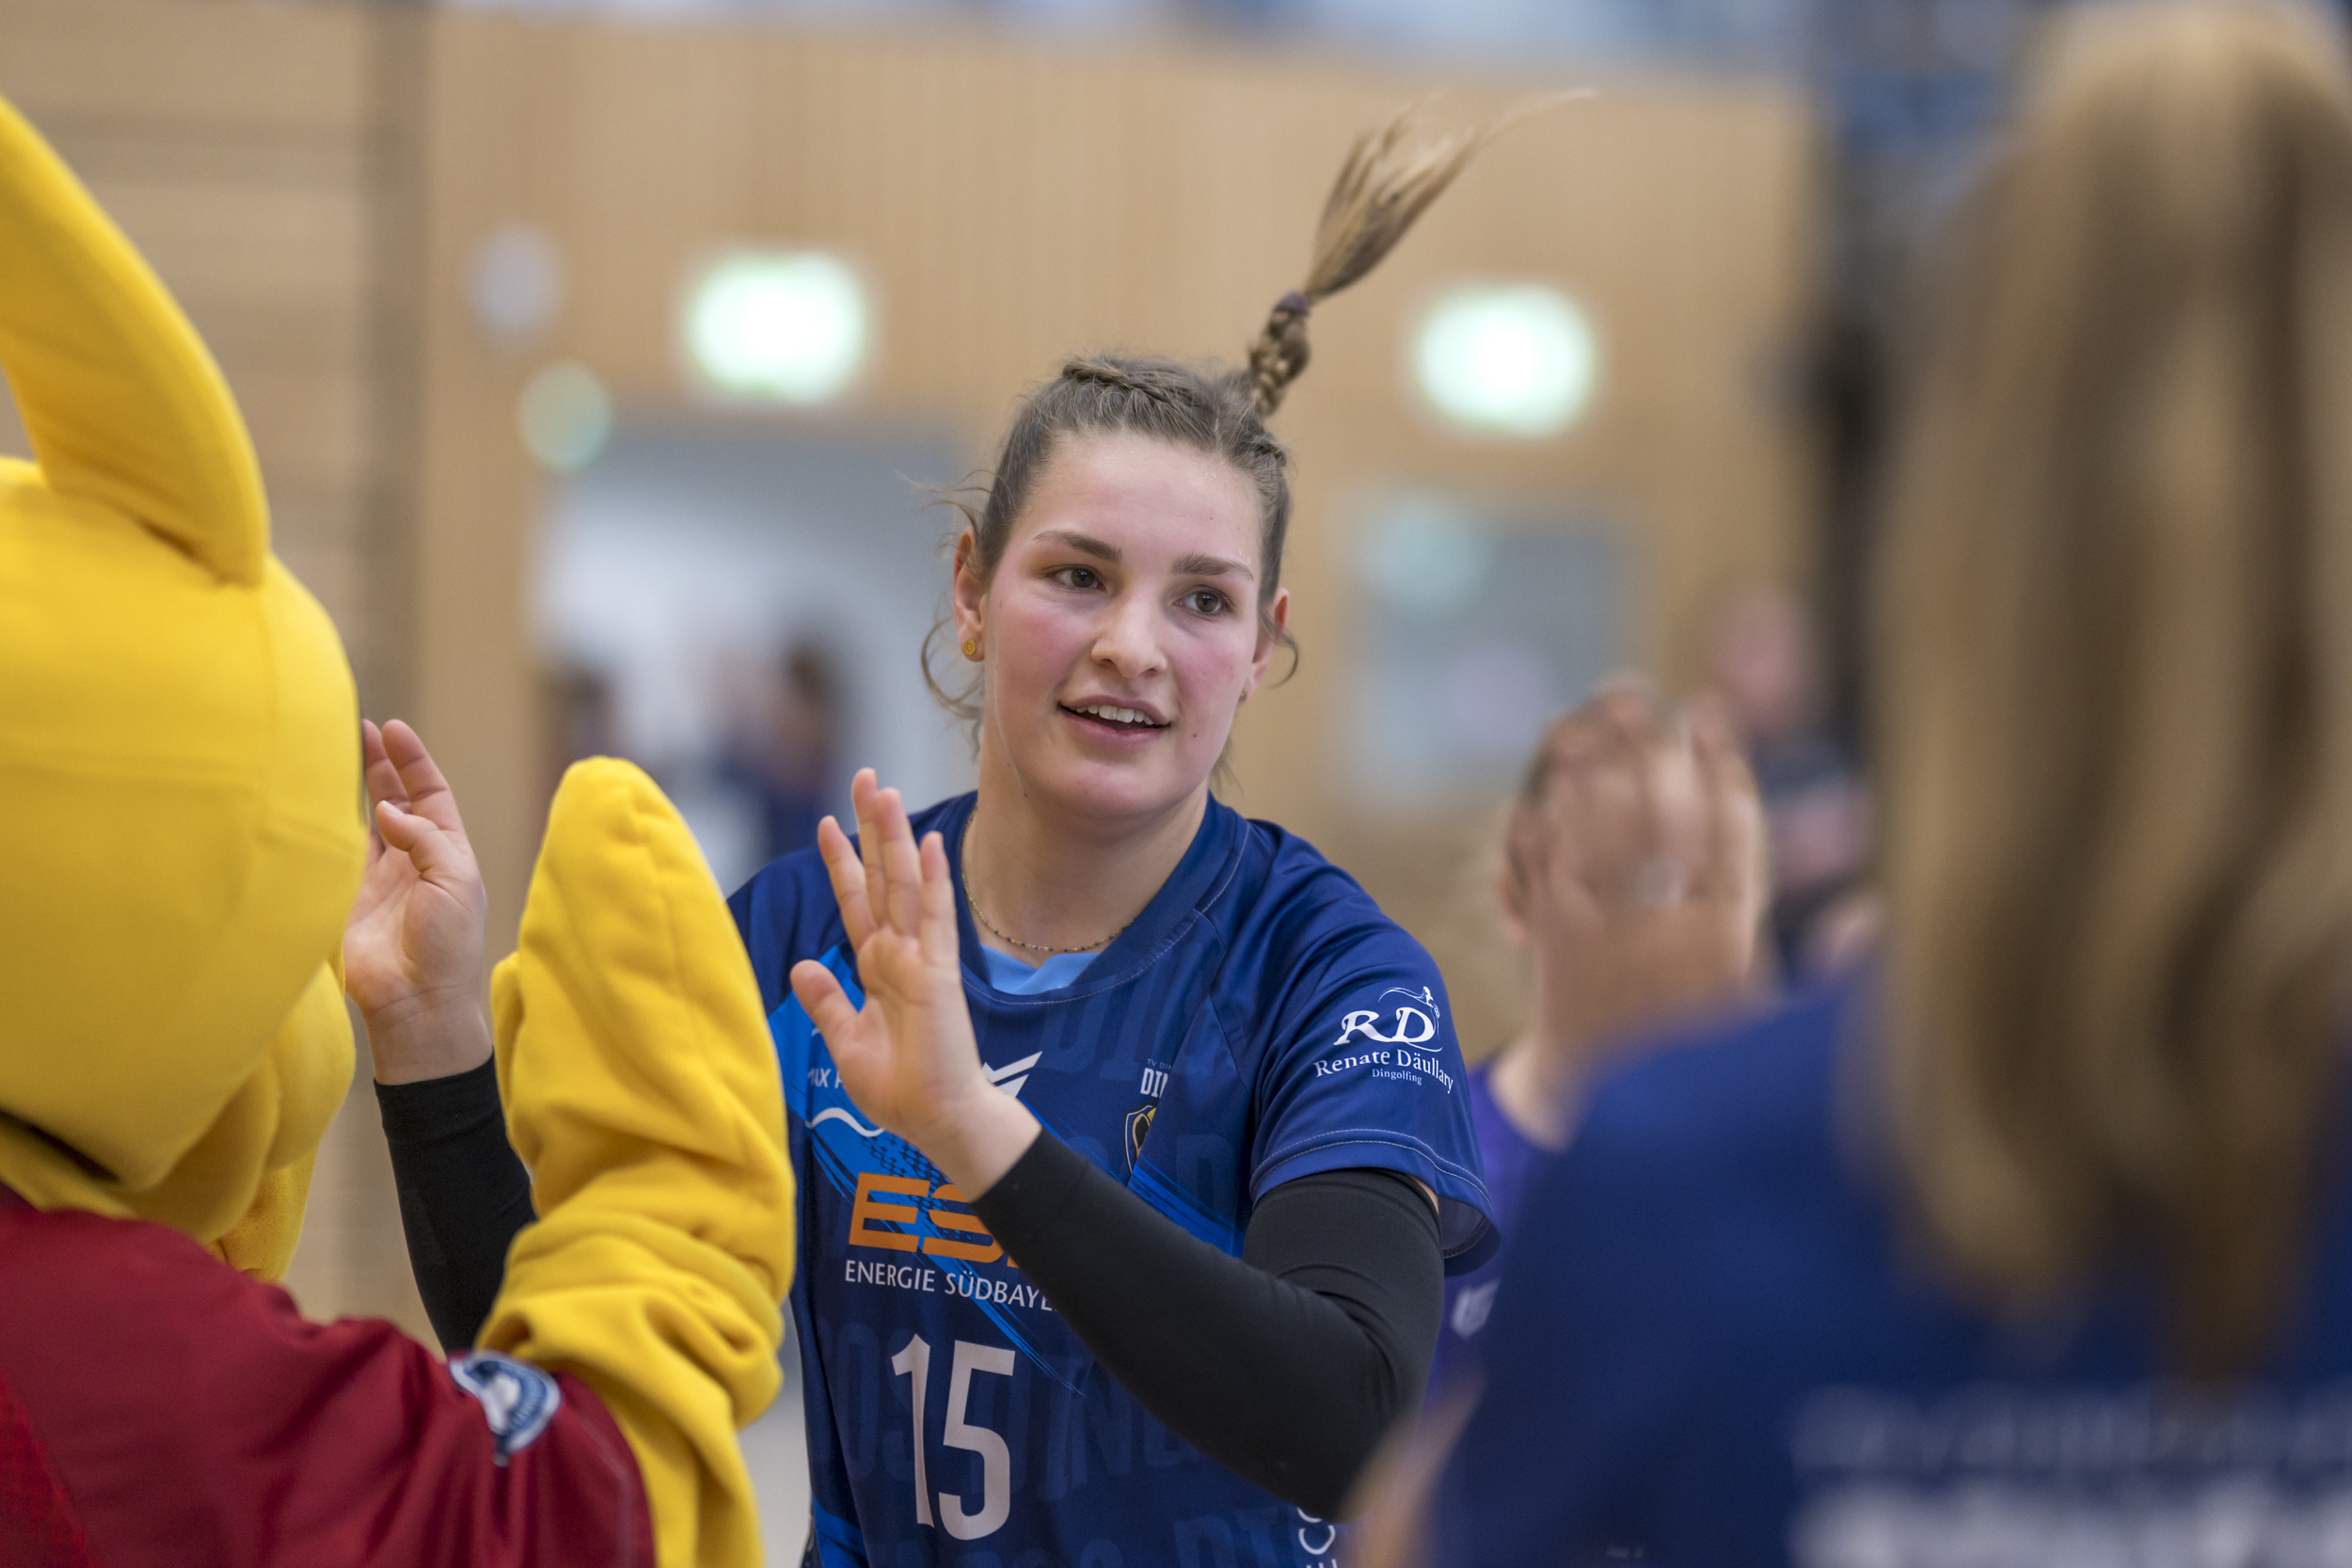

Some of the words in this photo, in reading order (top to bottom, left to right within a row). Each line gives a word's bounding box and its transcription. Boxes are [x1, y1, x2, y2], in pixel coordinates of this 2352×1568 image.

[1333, 1006, 1443, 1053] RD
[1312, 1051, 1391, 1078] Renate
[1397, 1049, 1454, 1095] Däullary
[1372, 1069, 1422, 1086] Dingolfing
[849, 1172, 1021, 1269] ES
[845, 1259, 935, 1292] ENERGIE
[945, 1270, 1057, 1312] SÜDBAY
[891, 1333, 1016, 1541] 15
